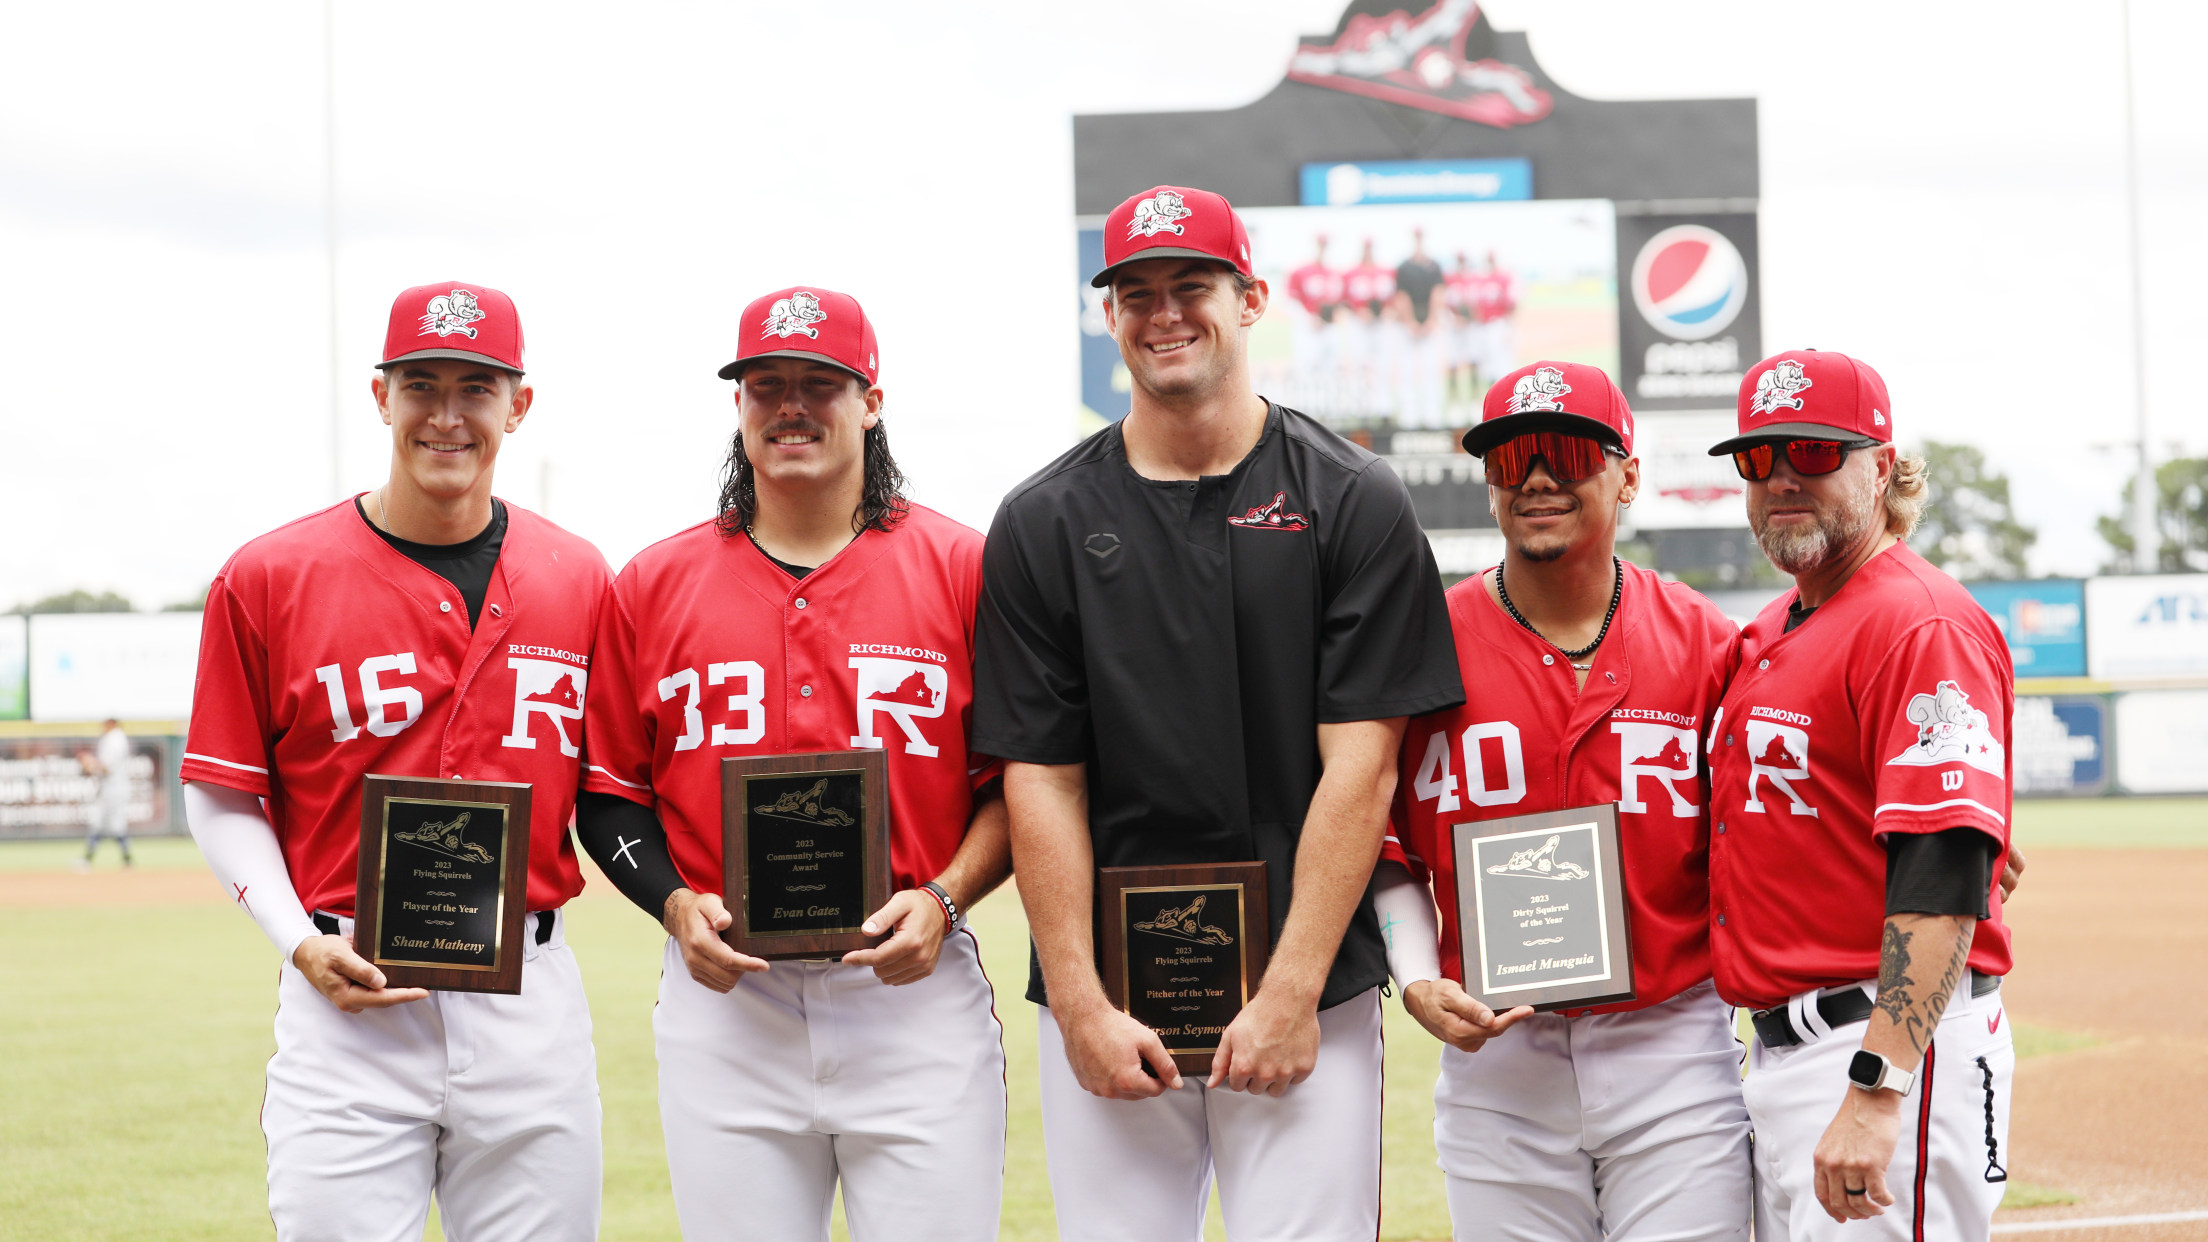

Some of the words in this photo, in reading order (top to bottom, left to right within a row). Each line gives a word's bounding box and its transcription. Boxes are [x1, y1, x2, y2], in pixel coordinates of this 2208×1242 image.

[848, 644, 947, 663] RICHMOND
[315, 652, 423, 743] 16
[501, 657, 588, 759] R
[658, 660, 765, 752] 33
[848, 656, 948, 758] R
[1750, 706, 1812, 726] RICHMOND
[1413, 720, 1527, 815] 40
[1610, 721, 1700, 818] R
[1744, 719, 1819, 819] R
[795, 840, 814, 848] 2023
[766, 852, 813, 861] Community
[815, 850, 844, 860] Service
[434, 861, 452, 869] 2023
[792, 863, 819, 872] Award
[413, 869, 437, 879] Flying
[438, 871, 472, 880] Squirrels
[1530, 894, 1549, 904] 2023
[402, 901, 431, 912] Player
[432, 903, 442, 912] of
[443, 904, 457, 913] the
[458, 905, 479, 914] Year
[773, 907, 804, 919] Evan
[807, 905, 840, 917] Gates
[1512, 908, 1534, 918] Dirty
[1535, 904, 1569, 915] Squirrel
[1520, 919, 1530, 928] of
[1530, 918, 1543, 927] the
[1544, 916, 1563, 925] Year
[392, 935, 429, 949] Shane
[432, 938, 485, 954] Matheny
[1175, 947, 1192, 955] 2023
[1155, 957, 1178, 966] Flying
[1180, 956, 1213, 965] Squirrels
[1496, 960, 1536, 976] Ismael
[1539, 953, 1594, 970] Munguia
[1146, 990, 1177, 999] Pitcher
[1178, 989, 1188, 998] of
[1189, 989, 1203, 997] the
[1204, 988, 1225, 997] Year
[1147, 1025, 1180, 1036] rson
[1183, 1023, 1225, 1037] Seymo
